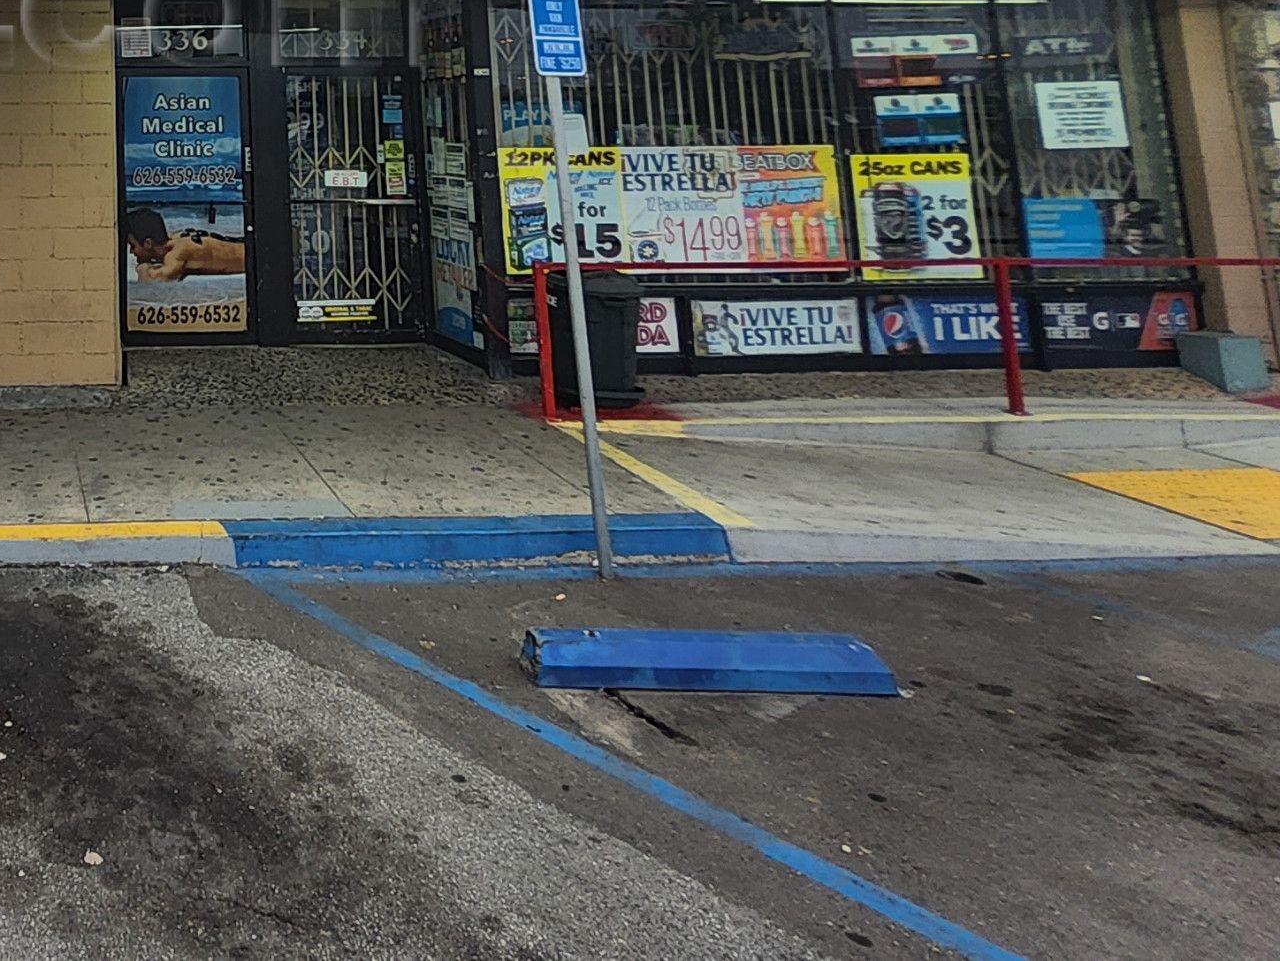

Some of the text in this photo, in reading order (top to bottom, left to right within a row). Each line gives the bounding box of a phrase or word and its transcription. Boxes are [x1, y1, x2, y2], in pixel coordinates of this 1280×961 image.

[159, 30, 208, 51] 336
[153, 93, 211, 110] Asian
[142, 115, 224, 134] Medical
[154, 139, 215, 157] Clinic
[568, 151, 616, 166] ANS
[683, 153, 715, 172] TU
[859, 158, 963, 176] 25oz CANS
[133, 165, 236, 186] 626-559-6532
[578, 201, 606, 218] for
[659, 197, 681, 212] Pack
[921, 194, 968, 210] 2 for
[926, 215, 972, 255] $3
[137, 305, 241, 325] 626-559-6532
[804, 306, 833, 325] TU
[933, 316, 945, 341] I
